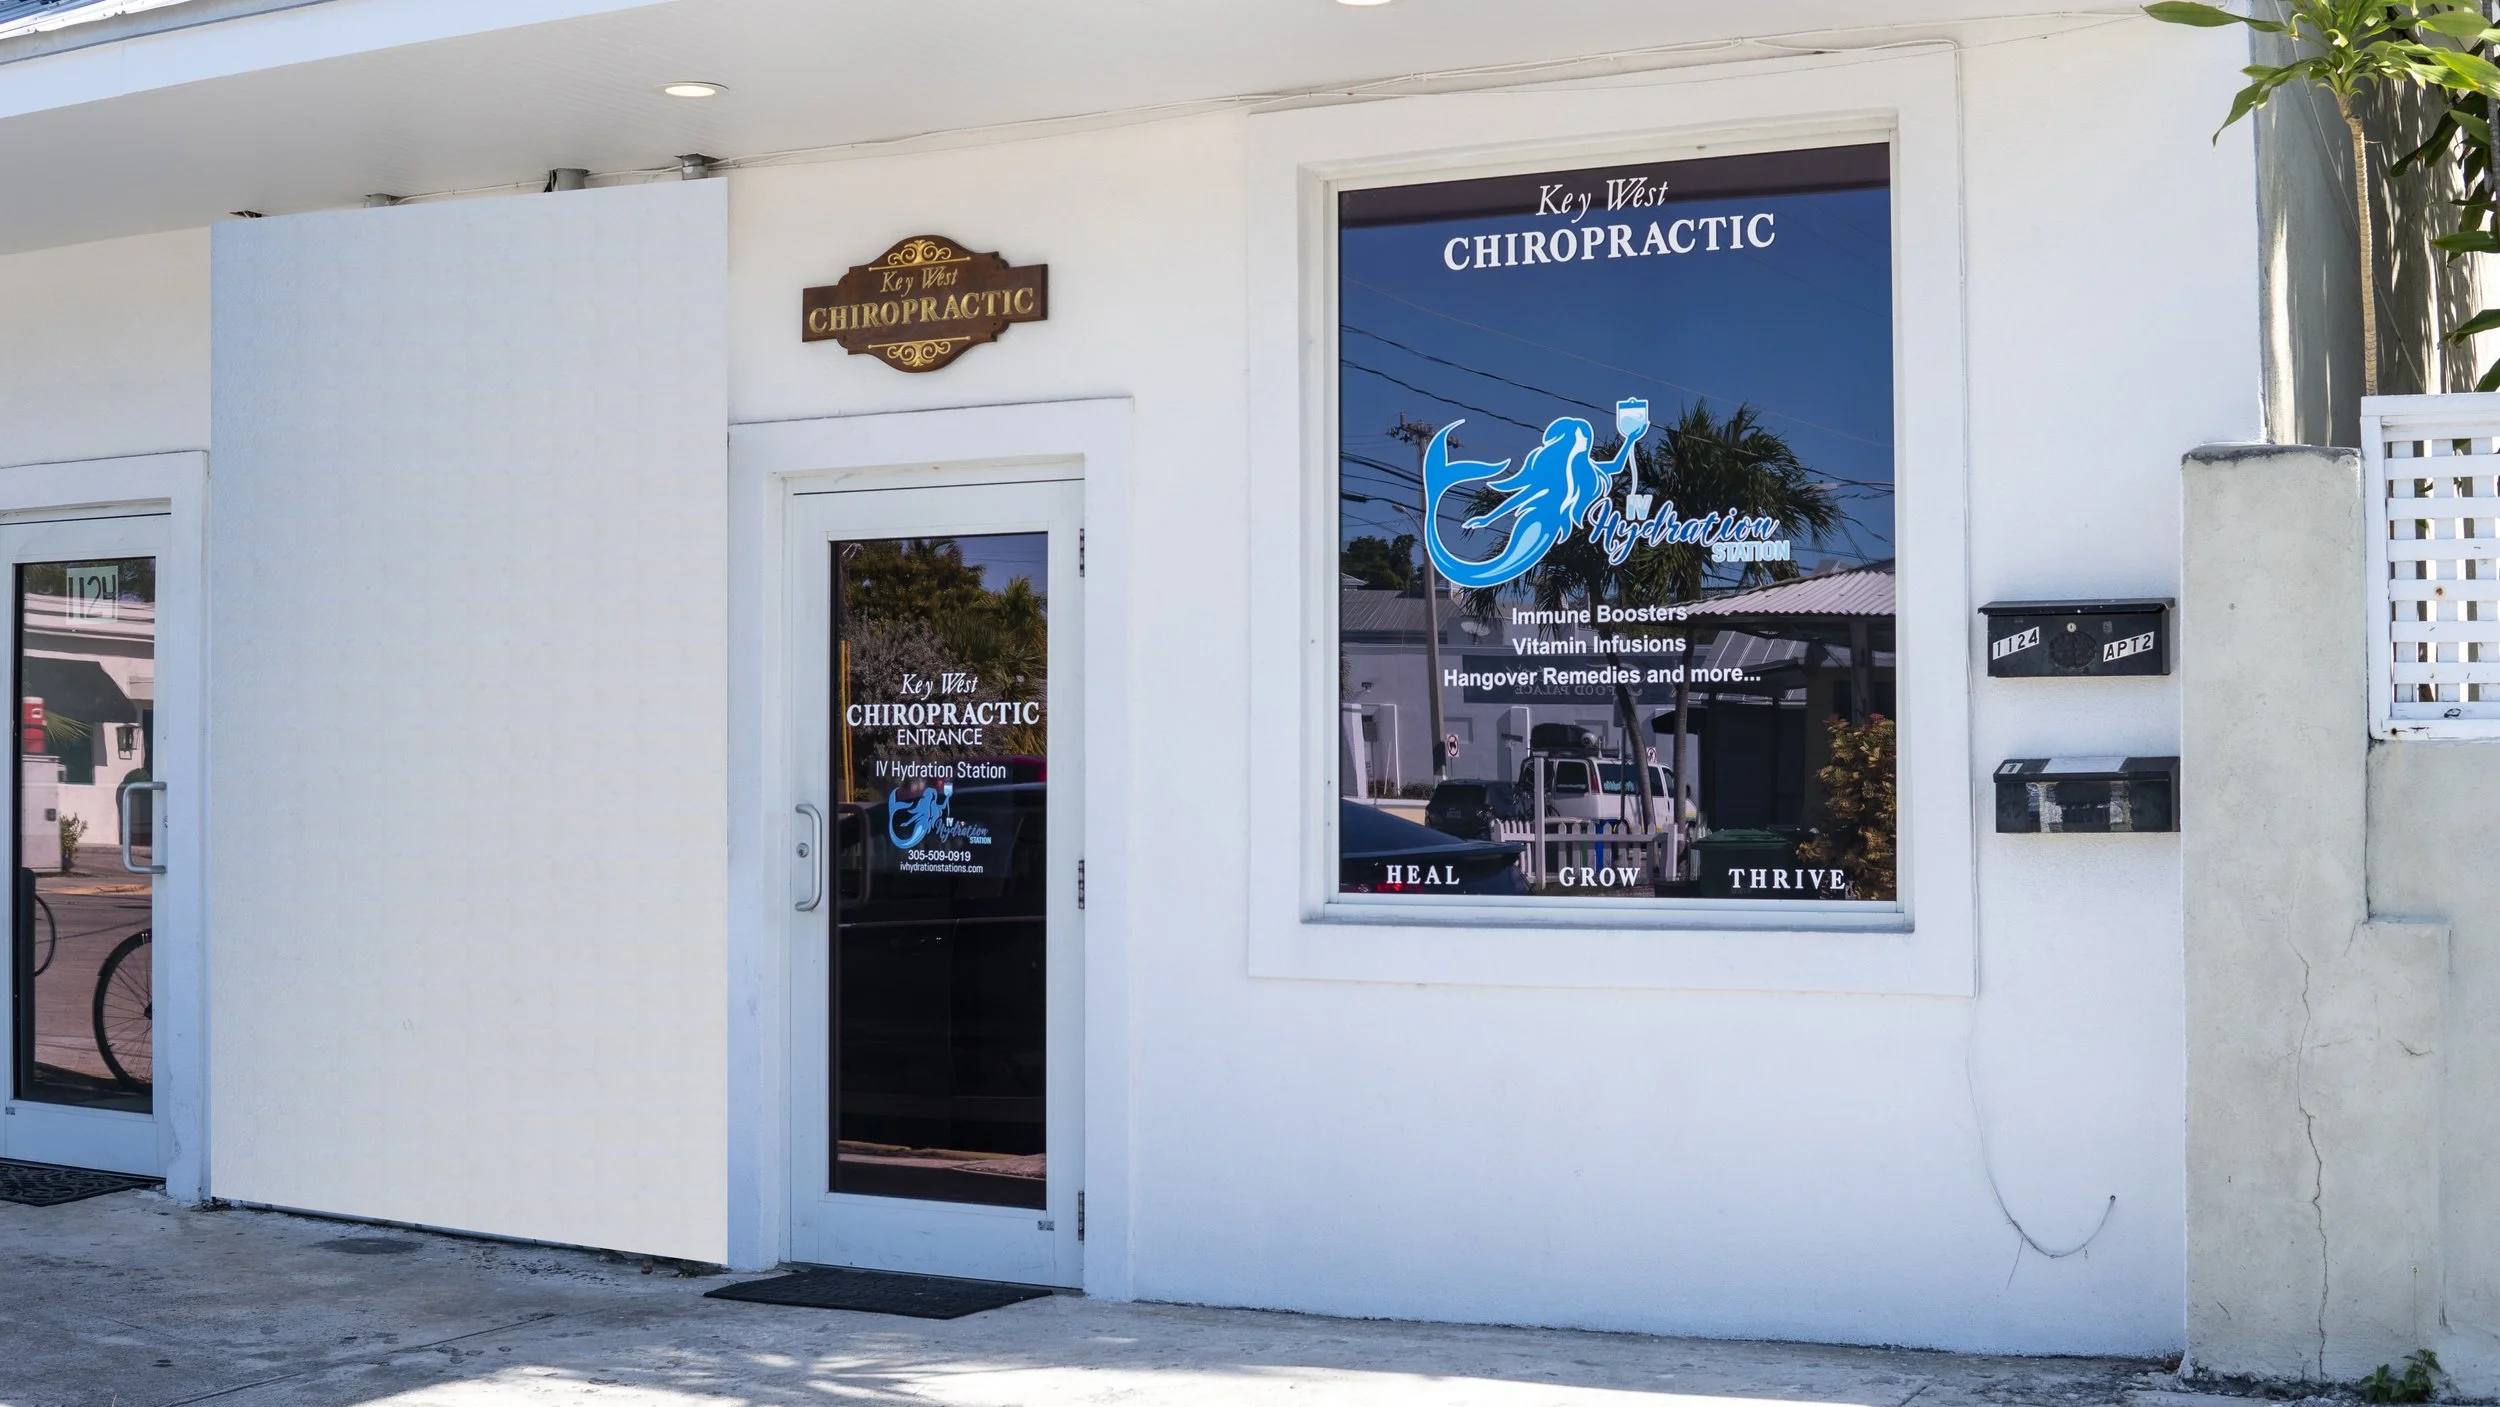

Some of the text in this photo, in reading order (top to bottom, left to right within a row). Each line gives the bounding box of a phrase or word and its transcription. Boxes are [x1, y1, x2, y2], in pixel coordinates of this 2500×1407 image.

[1535, 176, 1670, 224] Key West
[1443, 212, 1777, 271] CHIROPRACTIC
[880, 266, 959, 298] Key West
[808, 287, 1035, 334] CHIROPRACTIC
[1626, 494, 1653, 521] IV
[1588, 497, 1780, 566] Hydration
[1711, 540, 1791, 563] STATION
[68, 574, 116, 619] 1124
[1512, 604, 1688, 625] Immune Boosters
[1512, 634, 1687, 655] Vitamin Infusions
[1996, 628, 2039, 657] 1124
[900, 672, 978, 701] Key West
[1443, 668, 1537, 691] Hangover
[1543, 666, 1641, 685] Remedies
[1646, 665, 1685, 684] and
[1690, 666, 1761, 684] more...
[846, 701, 1040, 727] CHIROPRACTIC
[897, 728, 983, 746] ENTRANCE
[876, 760, 1006, 781] IV Hydration Station
[935, 818, 989, 843] Hydration
[946, 817, 954, 827] IV
[970, 836, 992, 844] STATION
[900, 861, 984, 873] ivhydrationstations.com
[908, 850, 971, 862] 305-509-0919
[1386, 865, 1460, 886] HEAL
[1558, 867, 1641, 887] GROW
[1728, 868, 1847, 891] THRIVE
